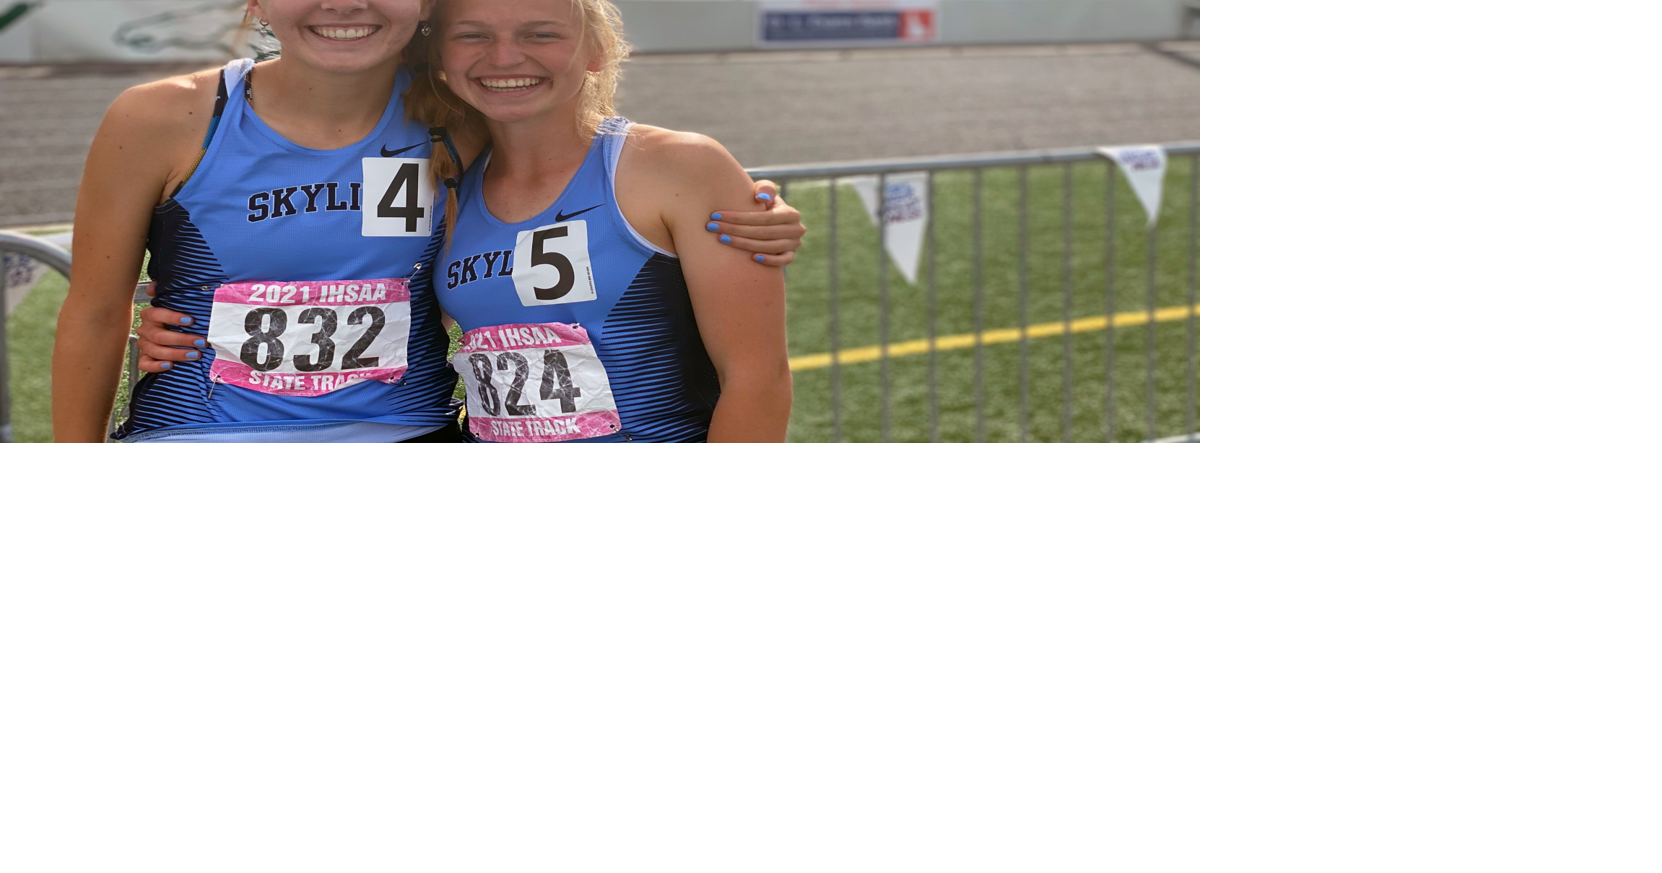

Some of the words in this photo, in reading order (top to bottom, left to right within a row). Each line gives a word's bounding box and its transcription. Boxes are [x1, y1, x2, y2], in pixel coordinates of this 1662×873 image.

[377, 163, 425, 233] 4
[530, 225, 576, 301] 5
[249, 283, 310, 304] 2021
[320, 282, 387, 303] IHSAA
[239, 305, 386, 373] 832
[498, 326, 562, 348] IHSAA
[248, 370, 306, 391] STATE
[310, 372, 372, 391] TRA
[467, 349, 582, 417] 824
[490, 419, 524, 438] STATE
[525, 417, 581, 437] TRACK
